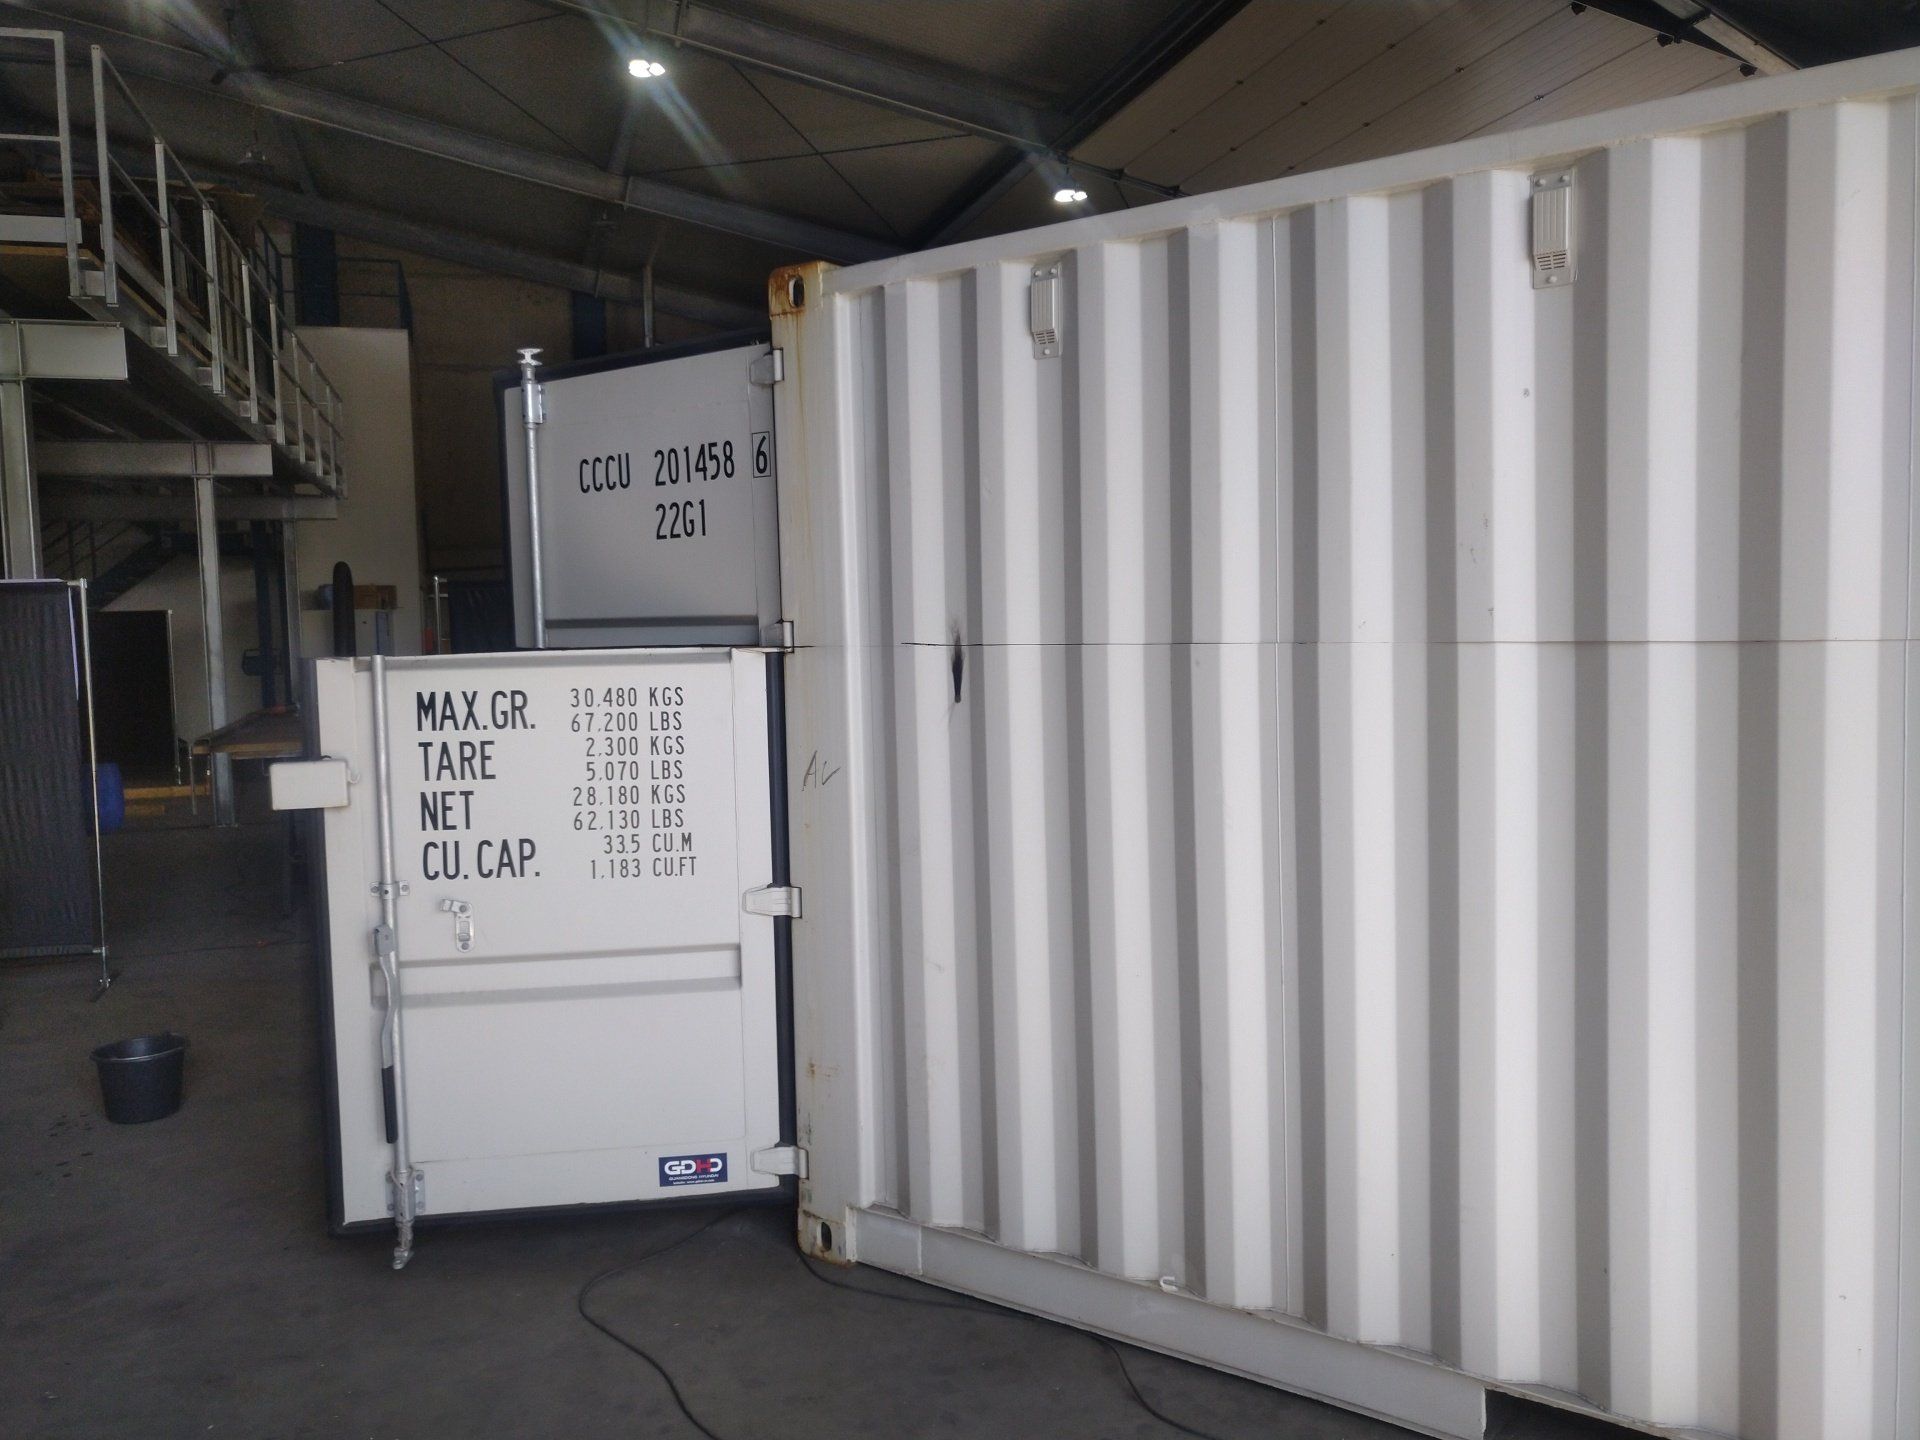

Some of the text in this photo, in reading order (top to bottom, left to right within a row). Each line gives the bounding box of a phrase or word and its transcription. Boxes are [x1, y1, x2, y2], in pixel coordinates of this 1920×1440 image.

[580, 436, 767, 493] CCCU 201458 6
[656, 499, 706, 540] 22G1
[650, 687, 683, 706] KGS
[650, 711, 682, 731] LBS
[651, 736, 684, 755] KGS
[418, 741, 496, 781] TARE
[651, 760, 682, 779] LBS
[652, 784, 685, 804] KGS
[420, 791, 474, 831] NET
[652, 809, 683, 828] LBS
[604, 834, 640, 854] 33.5
